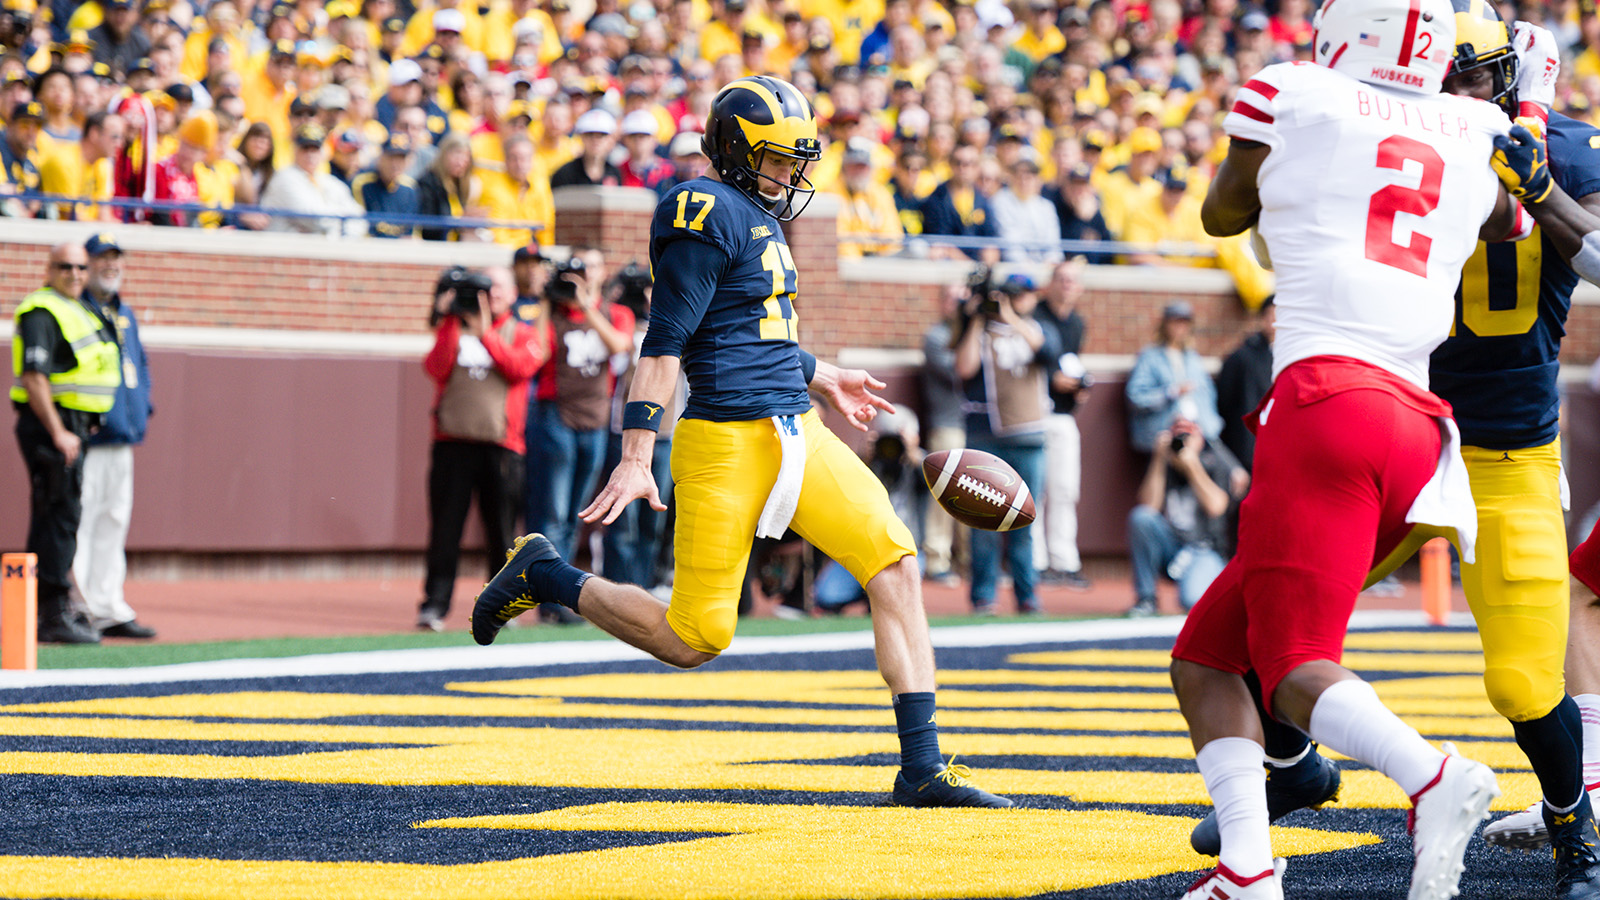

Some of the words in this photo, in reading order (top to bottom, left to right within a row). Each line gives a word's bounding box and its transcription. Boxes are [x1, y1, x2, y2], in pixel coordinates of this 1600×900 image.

[1414, 31, 1432, 60] 2
[1370, 67, 1425, 88] HUSKERS
[1357, 90, 1471, 143] BUTLER
[673, 190, 716, 232] 17
[1364, 134, 1446, 279] 2
[6, 564, 24, 579] M
[1553, 812, 1577, 826] M
